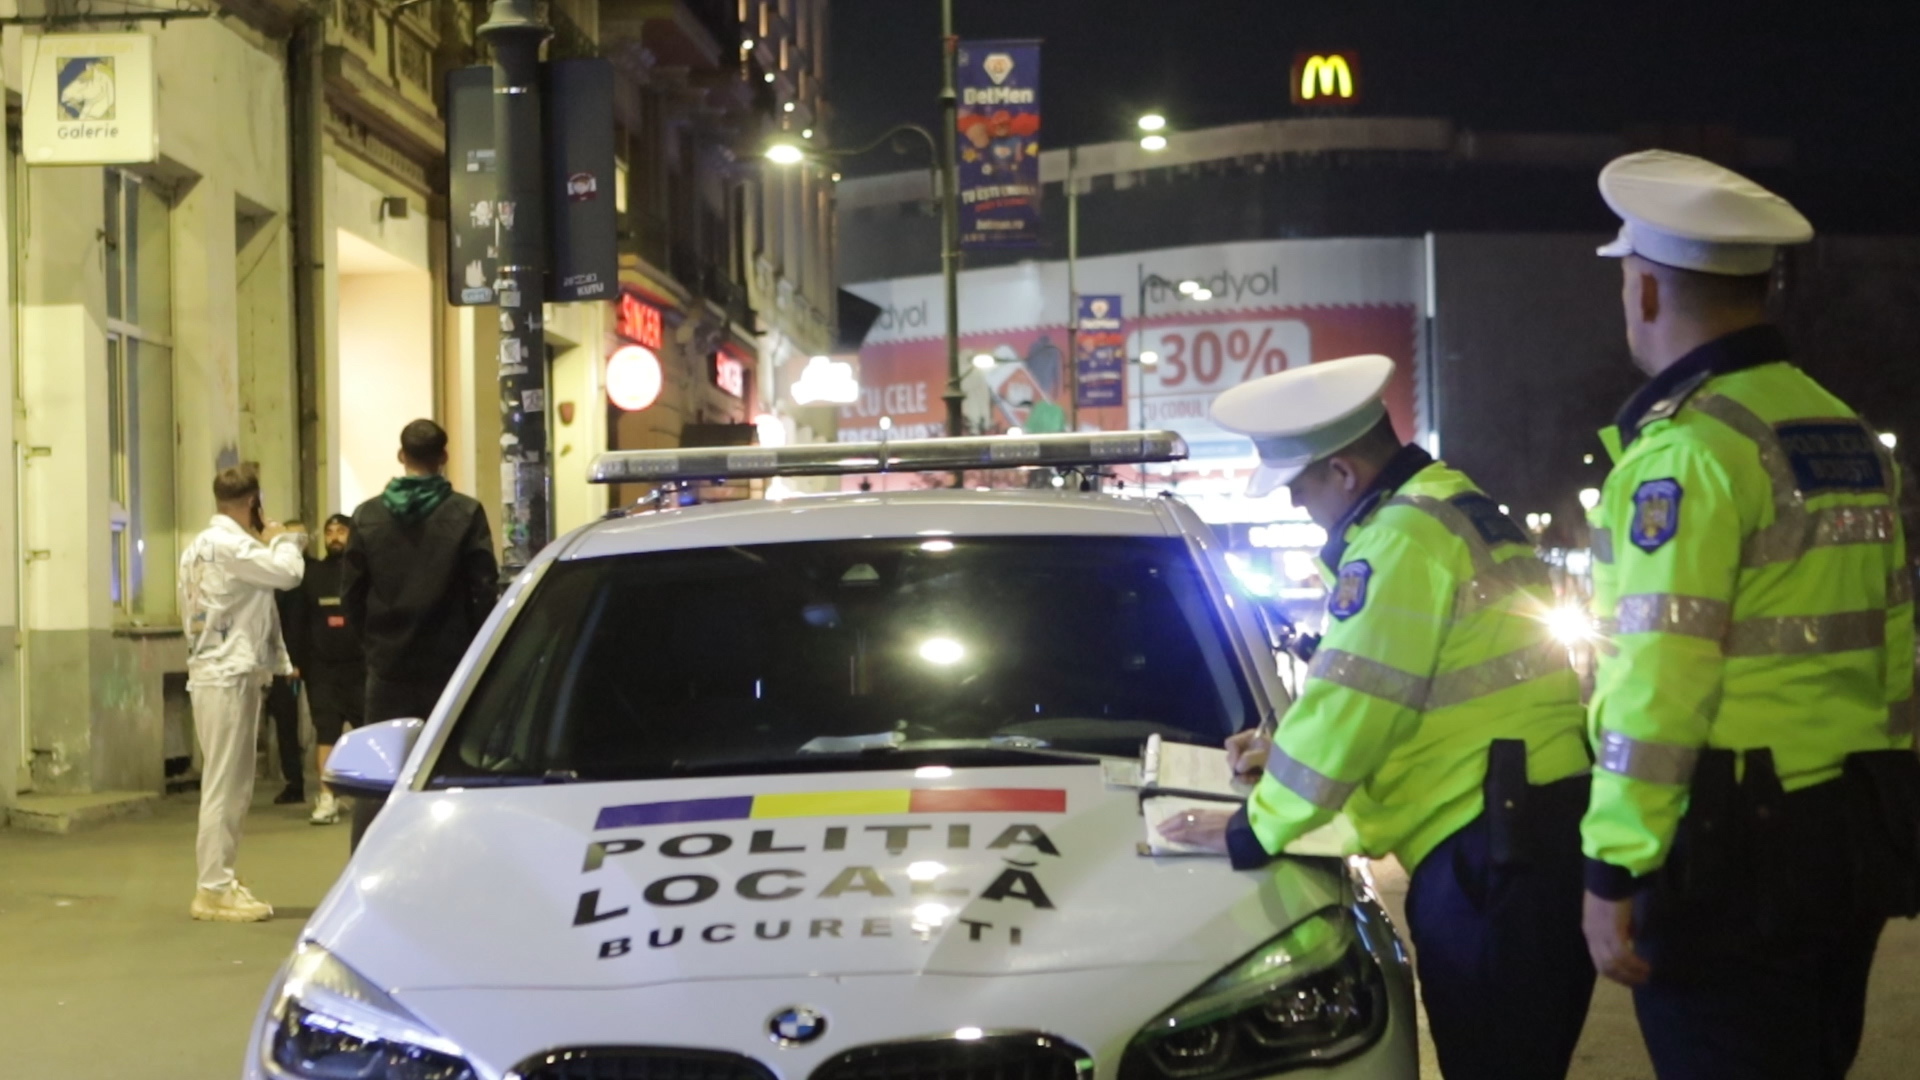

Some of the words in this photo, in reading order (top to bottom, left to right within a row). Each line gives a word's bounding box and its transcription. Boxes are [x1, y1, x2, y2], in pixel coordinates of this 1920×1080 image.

[57, 122, 119, 139] Galerie
[884, 381, 928, 416] CELE
[597, 917, 1022, 960] BUCURETI
